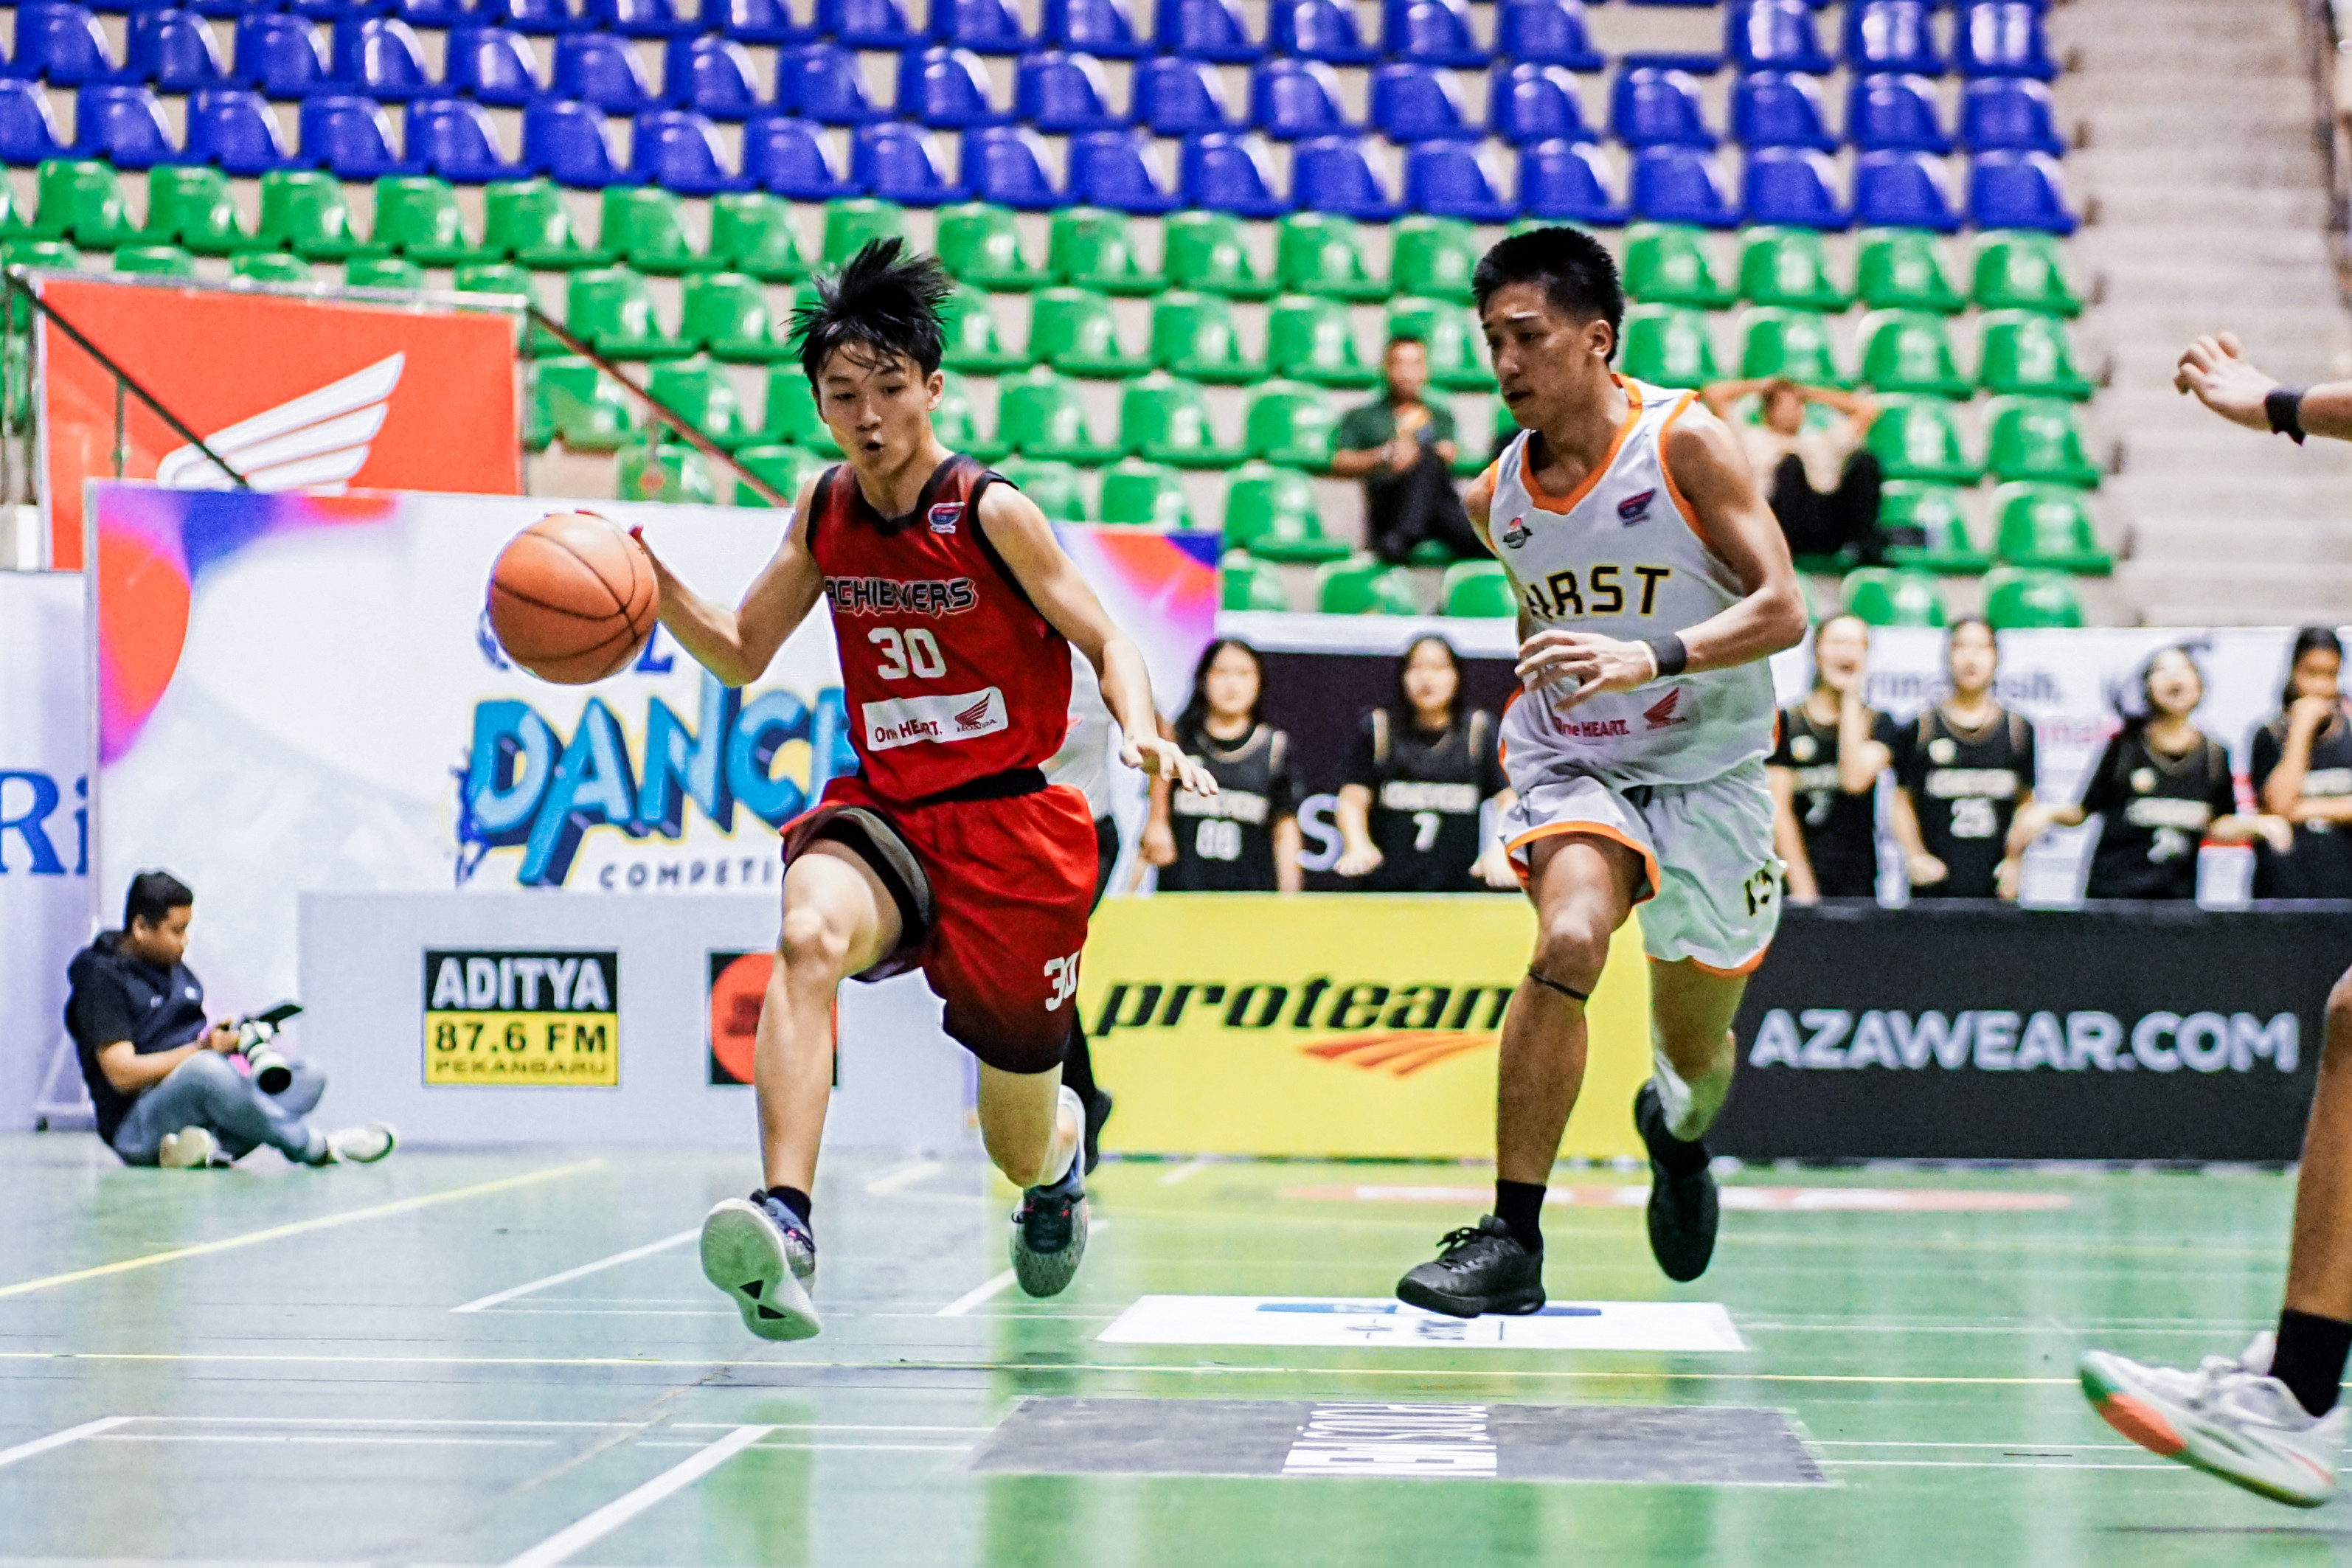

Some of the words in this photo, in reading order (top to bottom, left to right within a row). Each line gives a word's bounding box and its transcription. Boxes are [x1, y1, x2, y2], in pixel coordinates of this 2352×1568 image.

[824, 576, 979, 620] ACHIEVERS
[867, 627, 947, 679] 30
[431, 957, 611, 1010] ADITYA
[1044, 949, 1080, 1011] 30
[436, 1021, 526, 1052] 87.6
[546, 1022, 606, 1052] FM
[1748, 1007, 2301, 1072] AZAWEAR.COM
